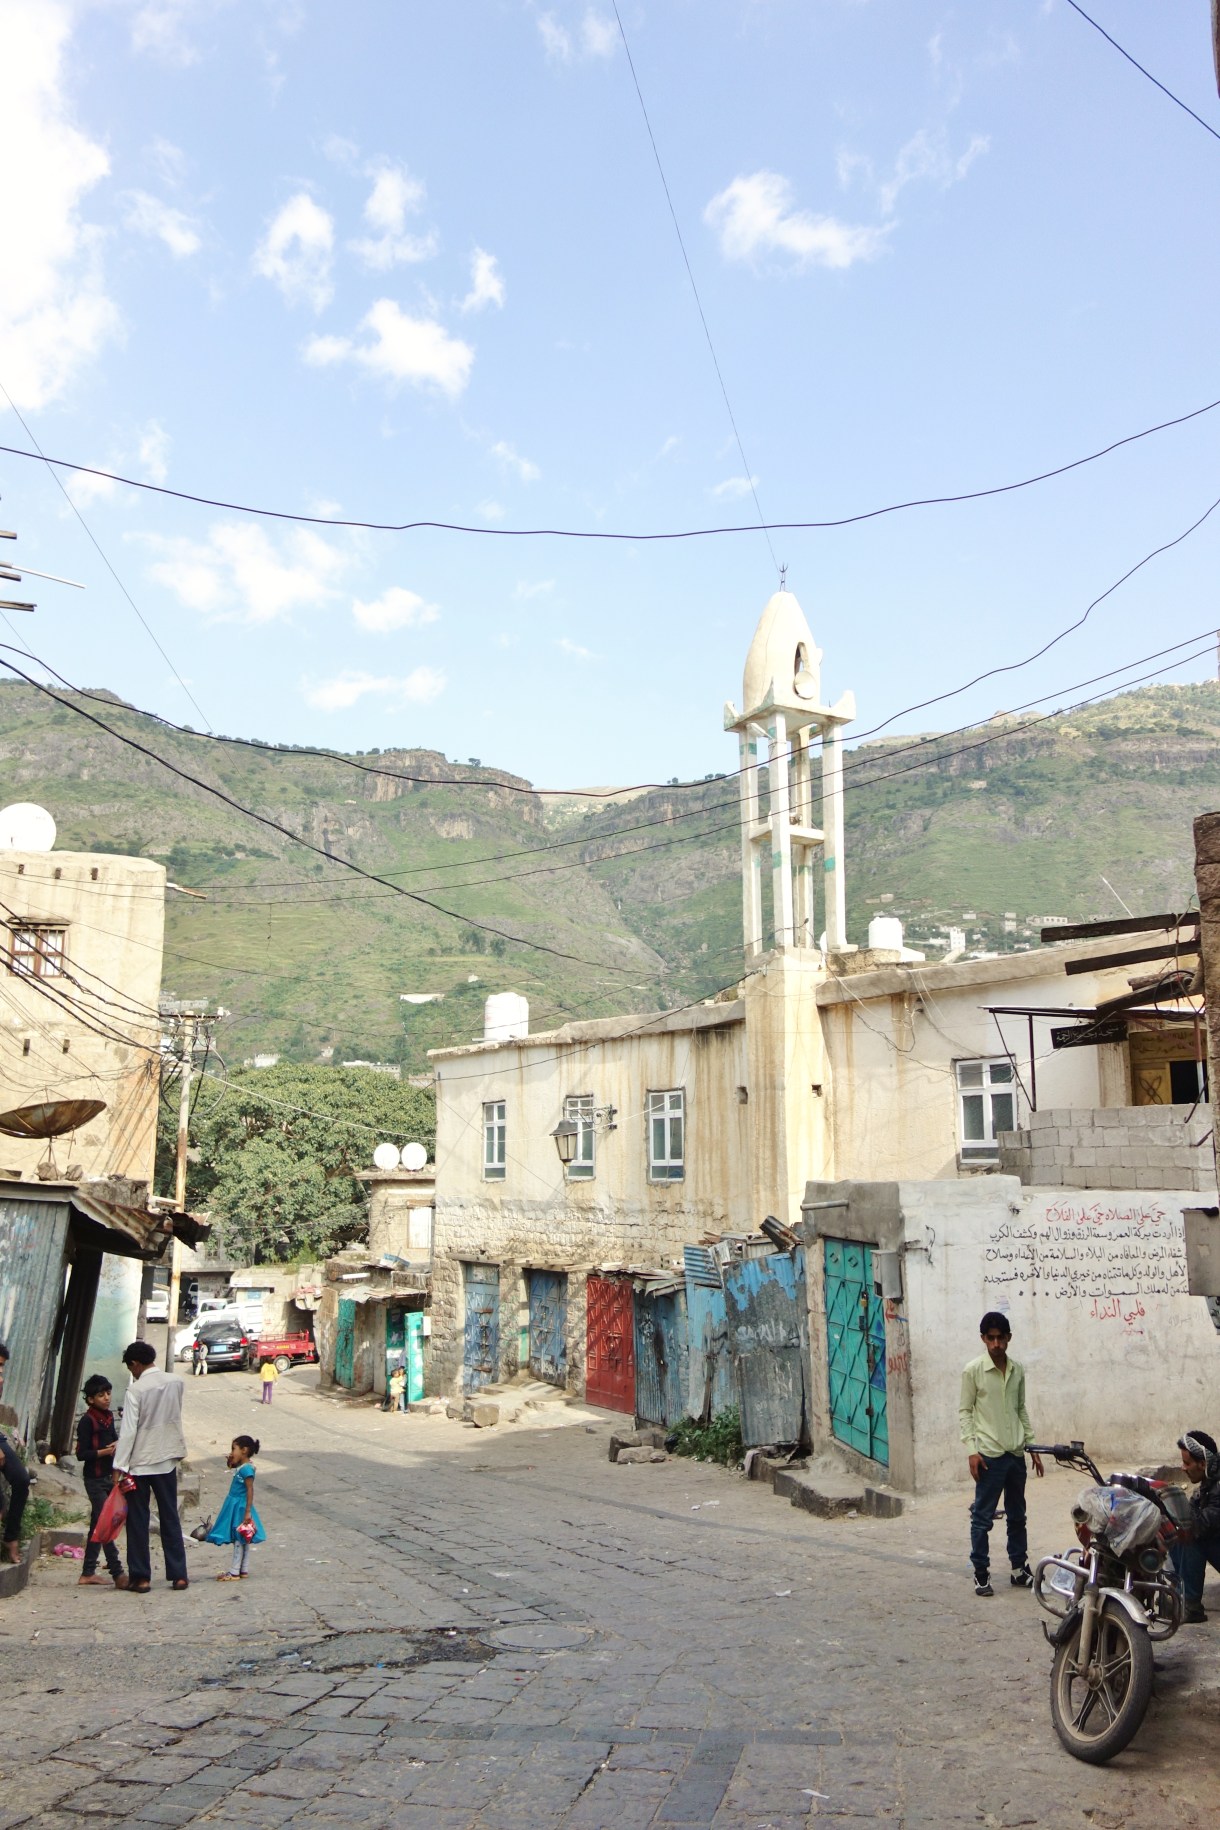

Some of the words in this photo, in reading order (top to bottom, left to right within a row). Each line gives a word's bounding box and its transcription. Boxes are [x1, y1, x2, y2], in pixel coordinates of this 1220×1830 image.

[989, 1224, 1012, 1243] الكرب
[1013, 1224, 1037, 1240] وكشف
[1040, 1226, 1054, 1245] الهم
[1054, 1226, 1075, 1242] وزوال
[1076, 1226, 1093, 1241] الرزق
[1092, 1227, 1113, 1241] وسعة
[1112, 1226, 1133, 1242] العمر
[1133, 1225, 1151, 1241] بركة
[1152, 1222, 1174, 1240] أردت
[986, 1248, 1014, 1262] وصلاح
[1014, 1244, 1039, 1261] الأعداء
[1039, 1253, 1049, 1263] من
[1050, 1247, 1084, 1261] والسلامة
[1085, 1246, 1105, 1262] البلاء
[1107, 1252, 1119, 1263] من
[1149, 1246, 1167, 1262] المرض
[983, 1268, 1019, 1285] فستجده
[1050, 1266, 1071, 1282] الدنيا
[1070, 1269, 1090, 1283] خيري
[1091, 1271, 1102, 1282] من
[1129, 1263, 1143, 1280] وكل
[1143, 1264, 1165, 1280] والولد
[1054, 1282, 1087, 1300] والأرض
[1089, 1282, 1143, 1299] السموات
[1143, 1283, 1161, 1295] ملك
[1161, 1283, 1169, 1295] له
[1089, 1297, 1121, 1321] النداء
[1124, 1298, 1146, 1325] فلبي
